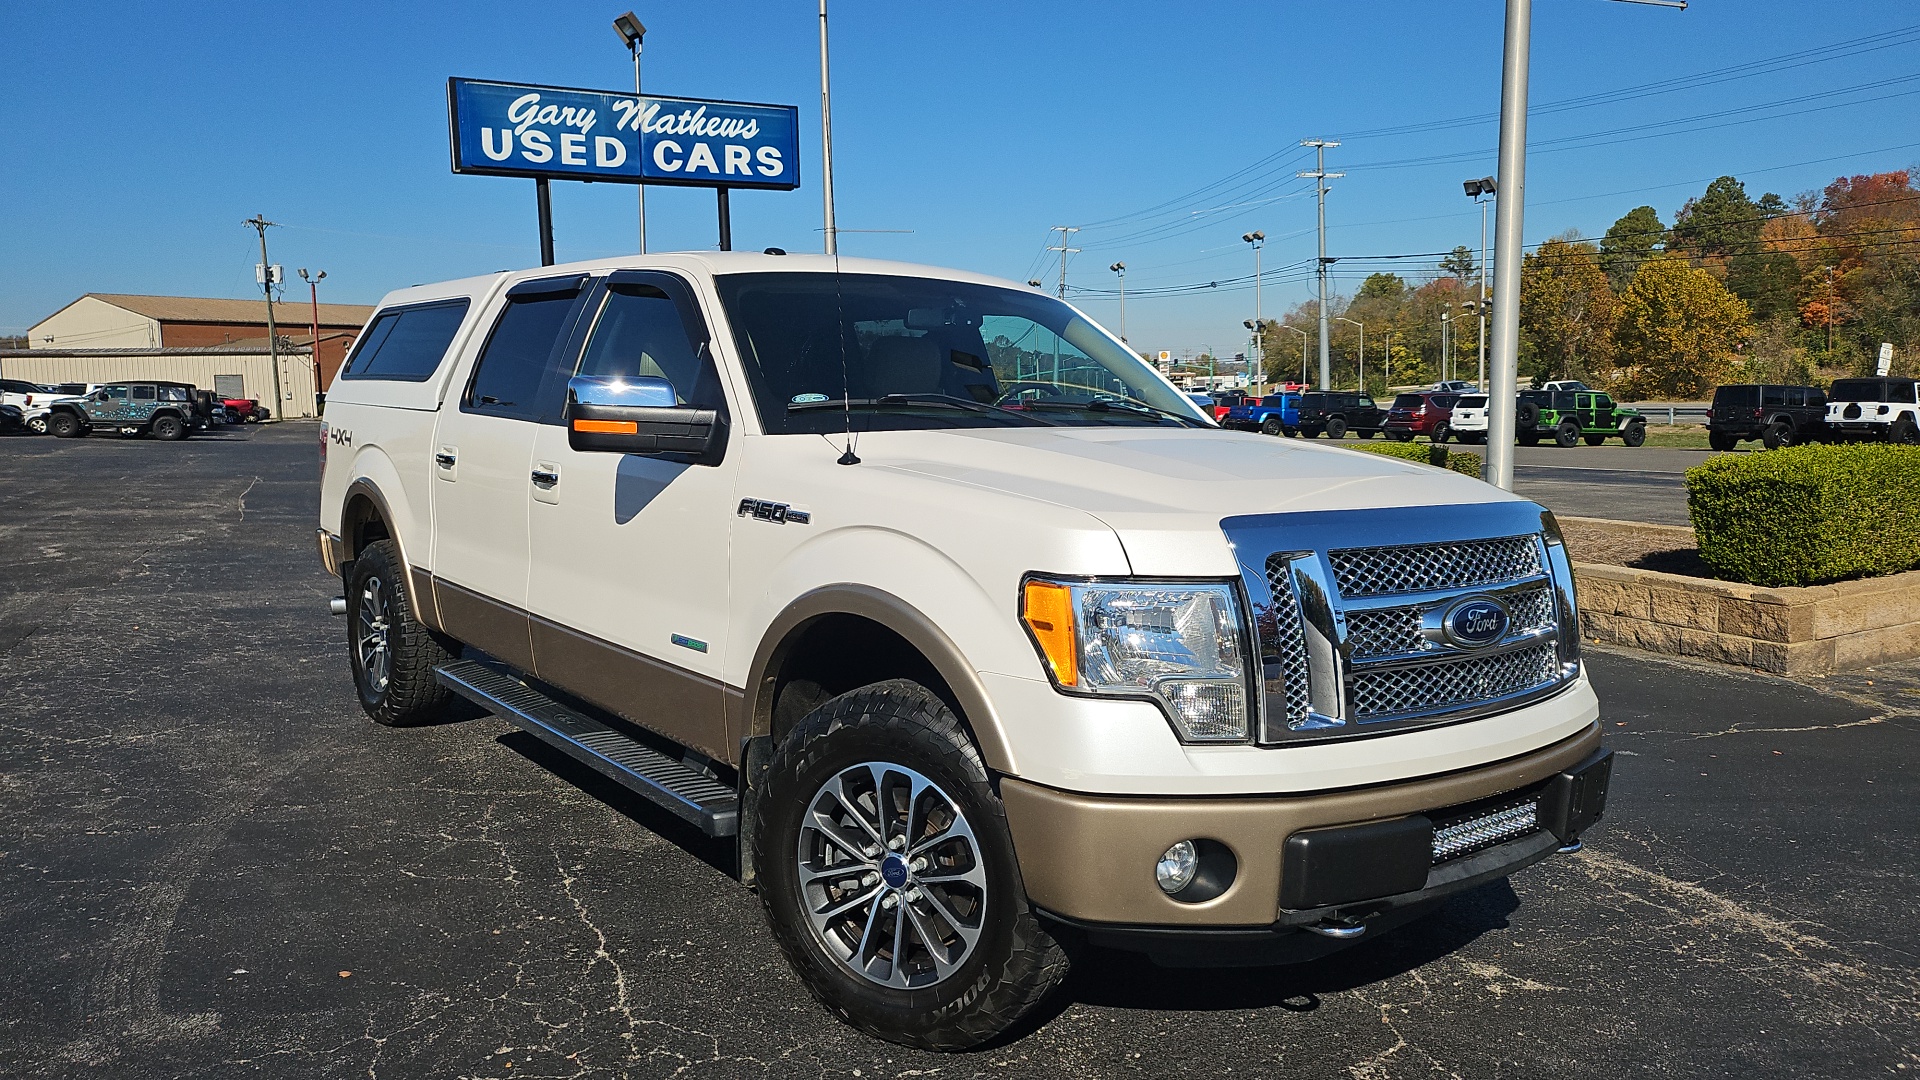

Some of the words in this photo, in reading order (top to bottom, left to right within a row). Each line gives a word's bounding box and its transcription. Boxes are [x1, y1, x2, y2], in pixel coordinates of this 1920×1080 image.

[507, 92, 597, 136] Gary
[612, 98, 760, 140] Mathews
[481, 127, 627, 168] USED
[653, 140, 784, 177] CARS
[1466, 608, 1498, 634] Ford
